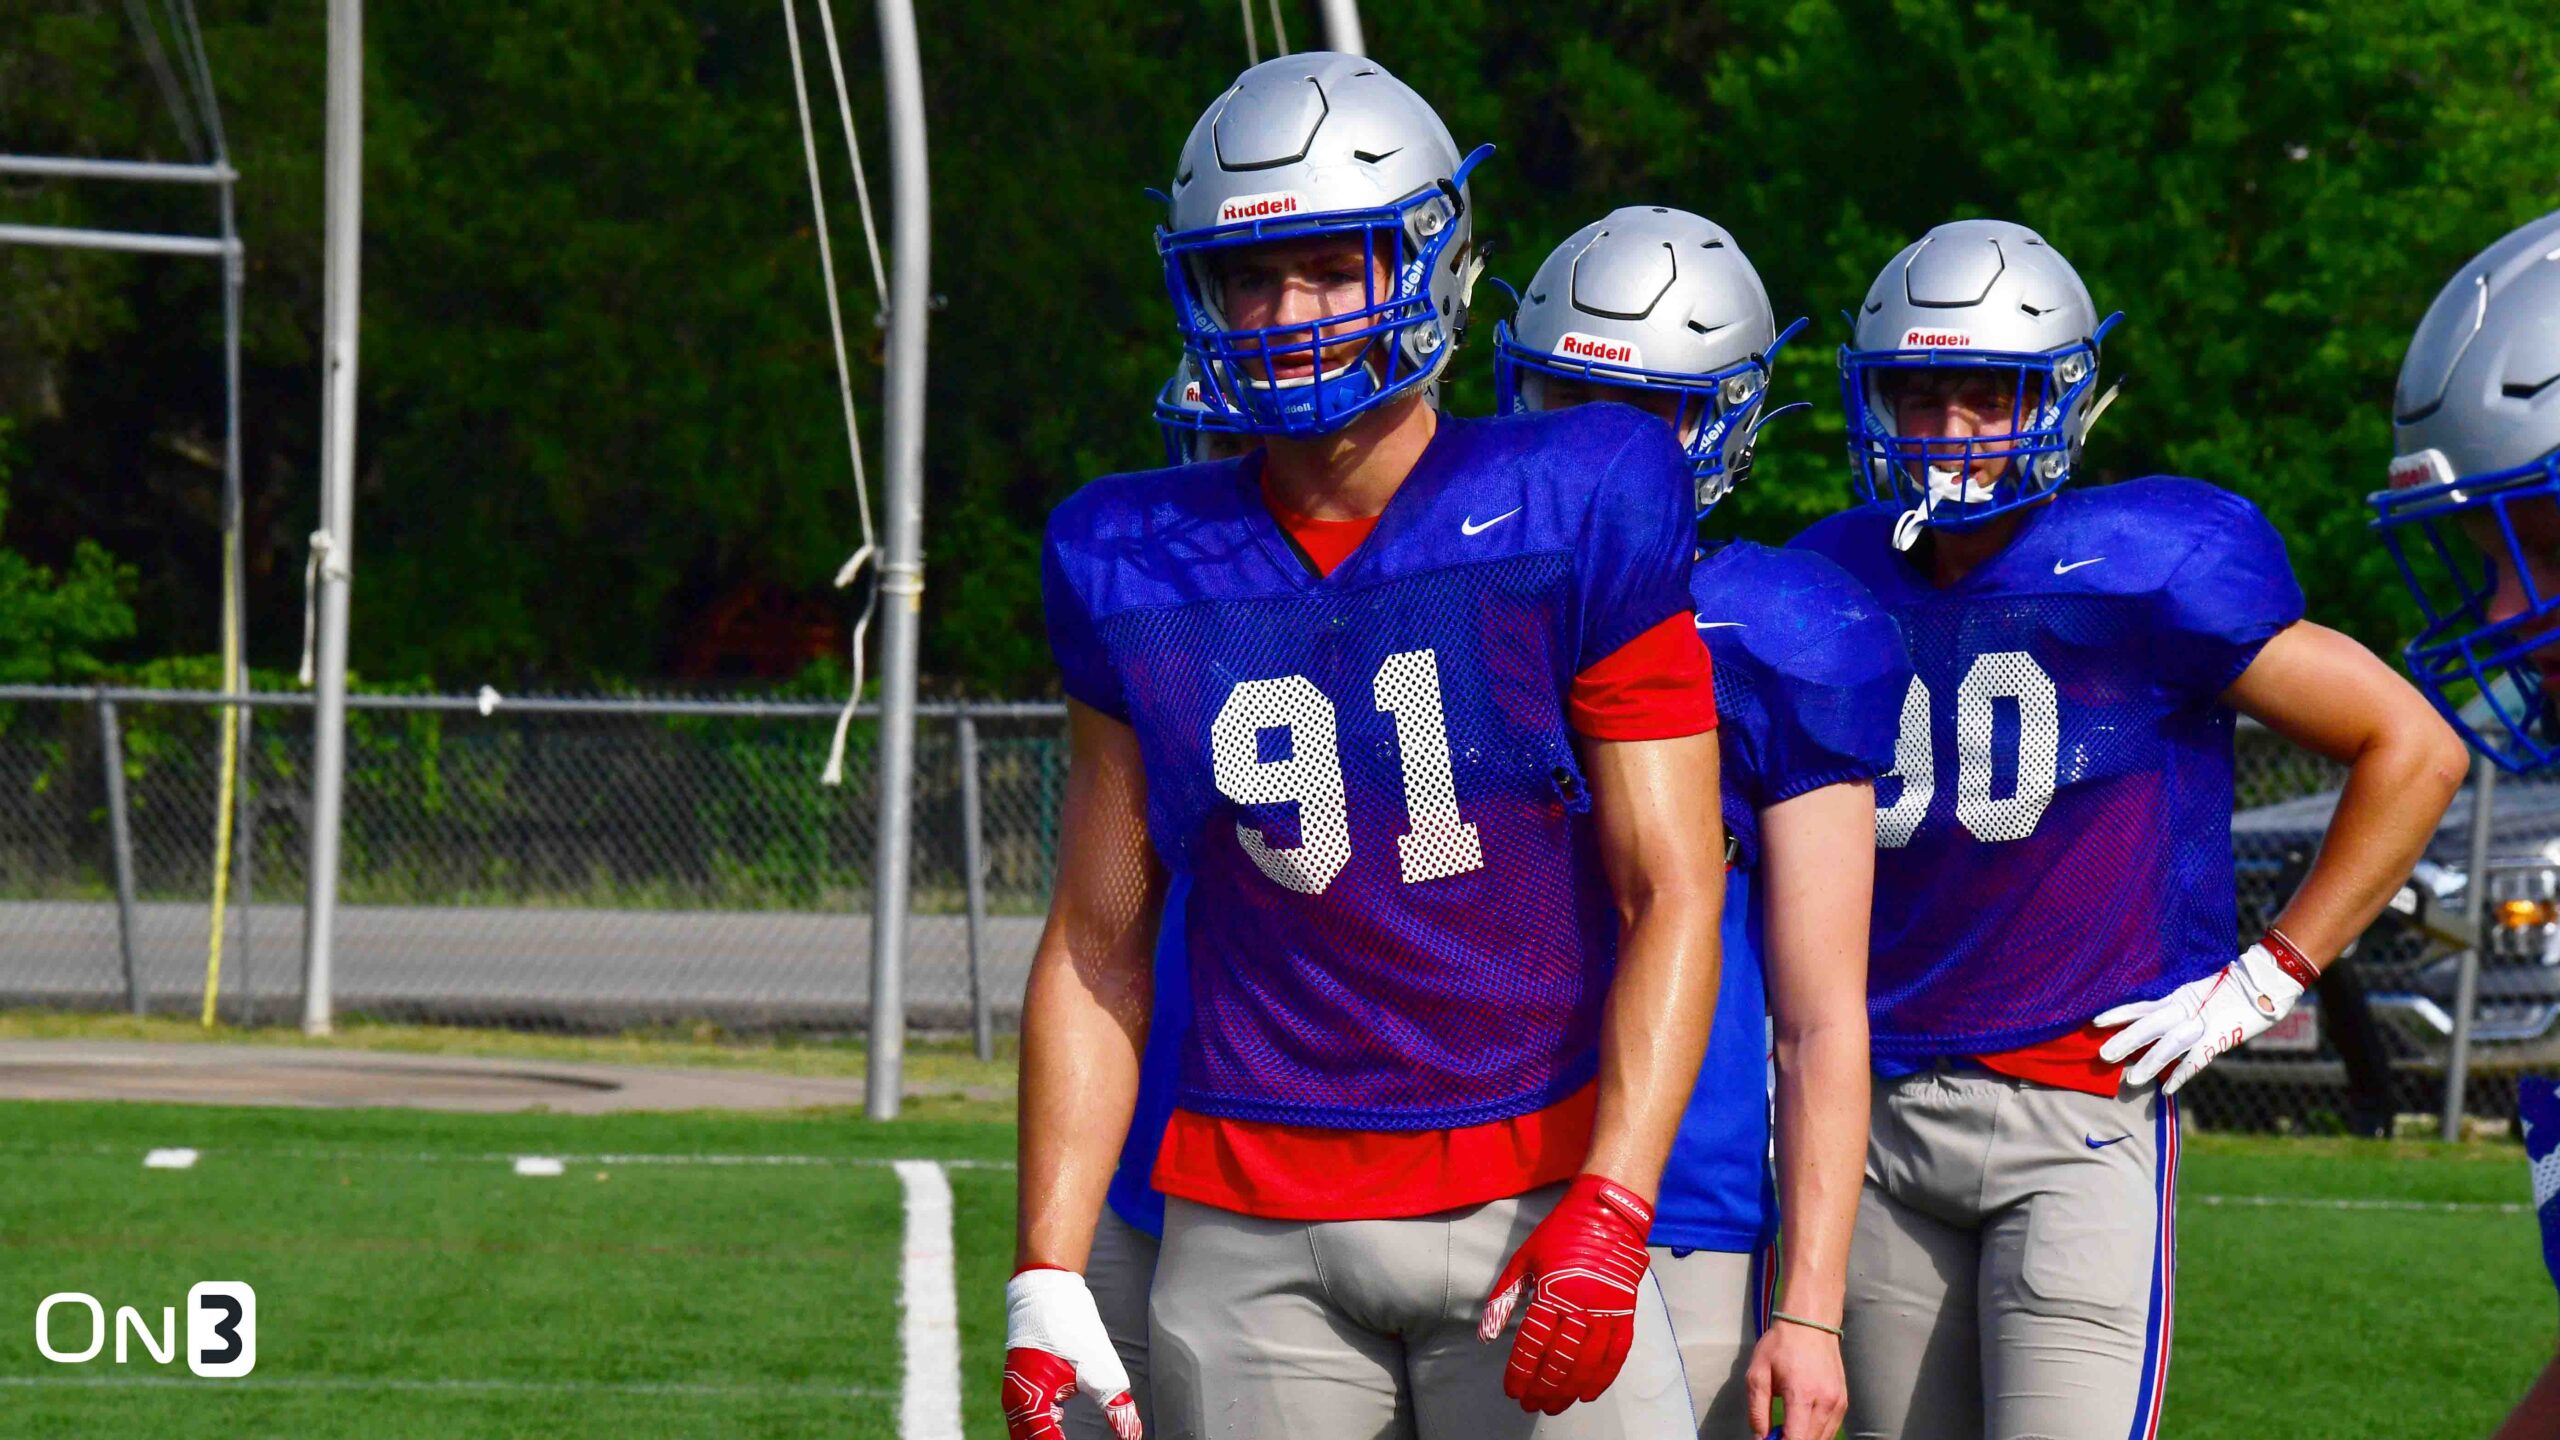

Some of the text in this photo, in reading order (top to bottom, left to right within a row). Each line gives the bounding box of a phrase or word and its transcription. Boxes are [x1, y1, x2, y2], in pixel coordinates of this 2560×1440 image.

[1224, 195, 1297, 220] Riddell
[1563, 336, 1632, 363] Riddell
[1907, 332, 1970, 346] Riddell
[1211, 648, 1484, 895] 91
